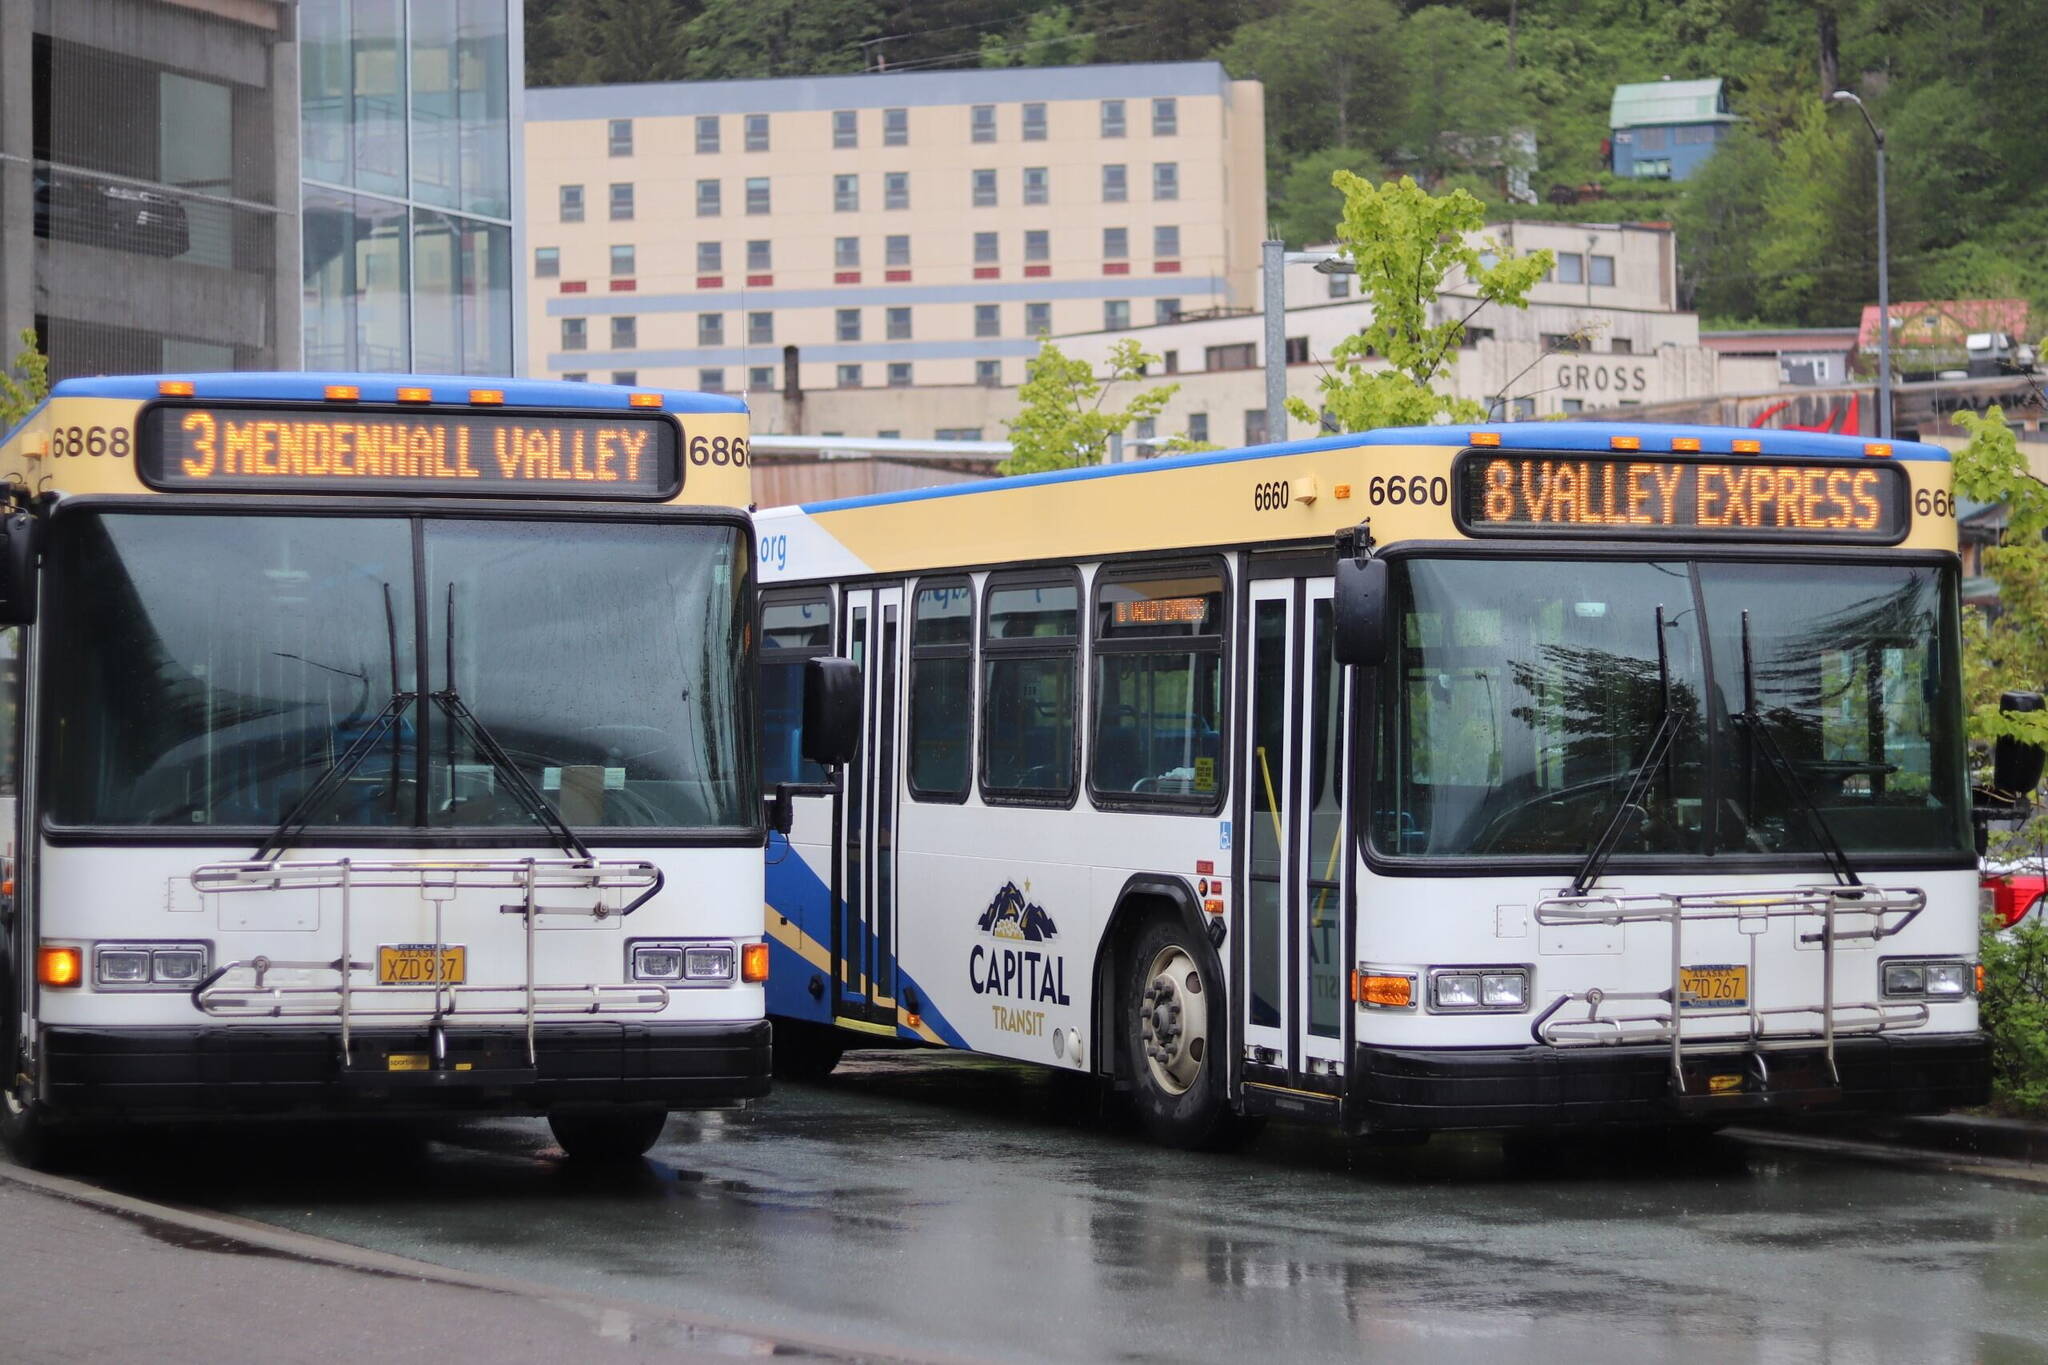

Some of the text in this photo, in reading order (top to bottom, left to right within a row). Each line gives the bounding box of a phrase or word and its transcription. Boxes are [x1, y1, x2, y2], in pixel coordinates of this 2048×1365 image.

[1558, 365, 1647, 391] GROSS
[53, 426, 130, 458] 6868
[182, 410, 648, 481] 3 MENDENHALL VALLEY
[1254, 480, 1289, 511] 6660
[1369, 475, 1448, 506] 6660
[1486, 459, 1880, 529] 8 VALLEY EXPRESS
[388, 959, 420, 980] XZD
[969, 944, 1070, 1006] CAPITAL
[1714, 977, 1740, 998] 267
[992, 1005, 1045, 1037] TRANSIT
